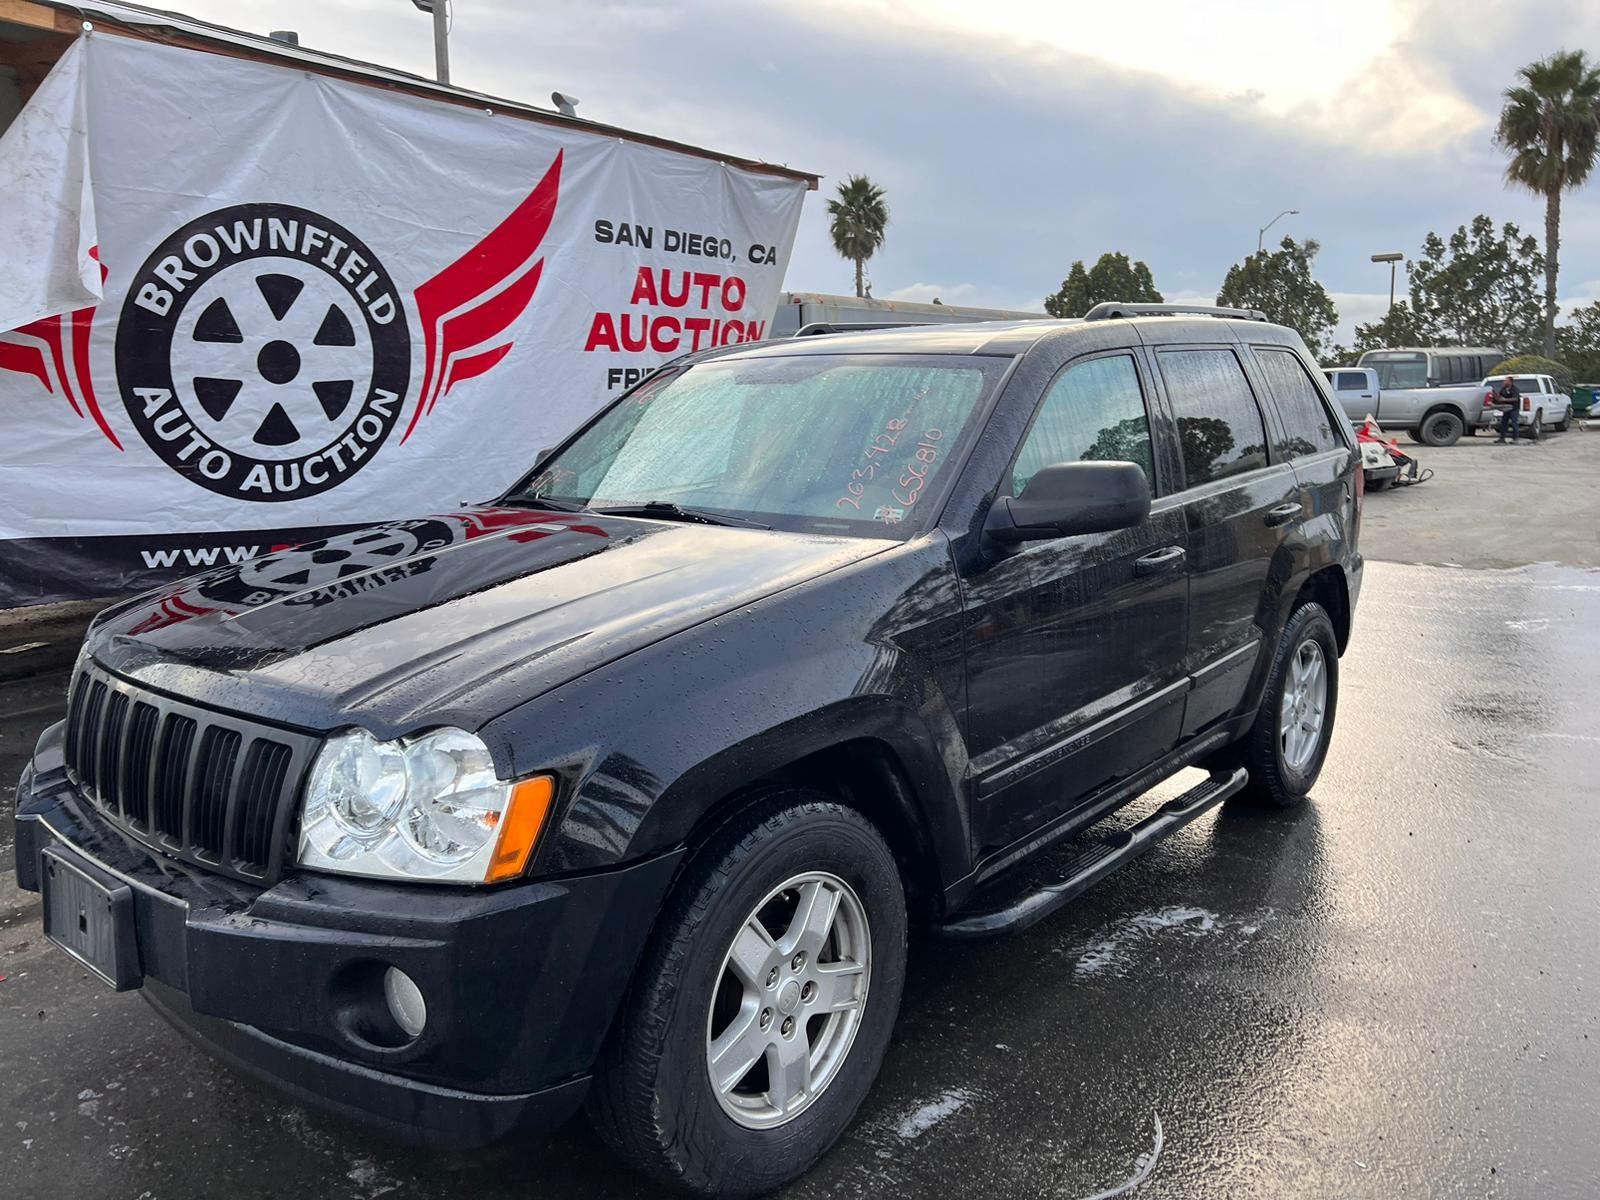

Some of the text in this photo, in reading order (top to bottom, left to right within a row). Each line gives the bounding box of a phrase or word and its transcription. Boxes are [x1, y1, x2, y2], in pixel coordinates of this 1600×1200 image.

[594, 219, 777, 266] SAN DIEGO, CA
[134, 217, 397, 326] BROWNFIELD
[630, 265, 747, 313] AUTO
[584, 312, 766, 354] AUCTION
[132, 386, 399, 493] AUTO AUCTION
